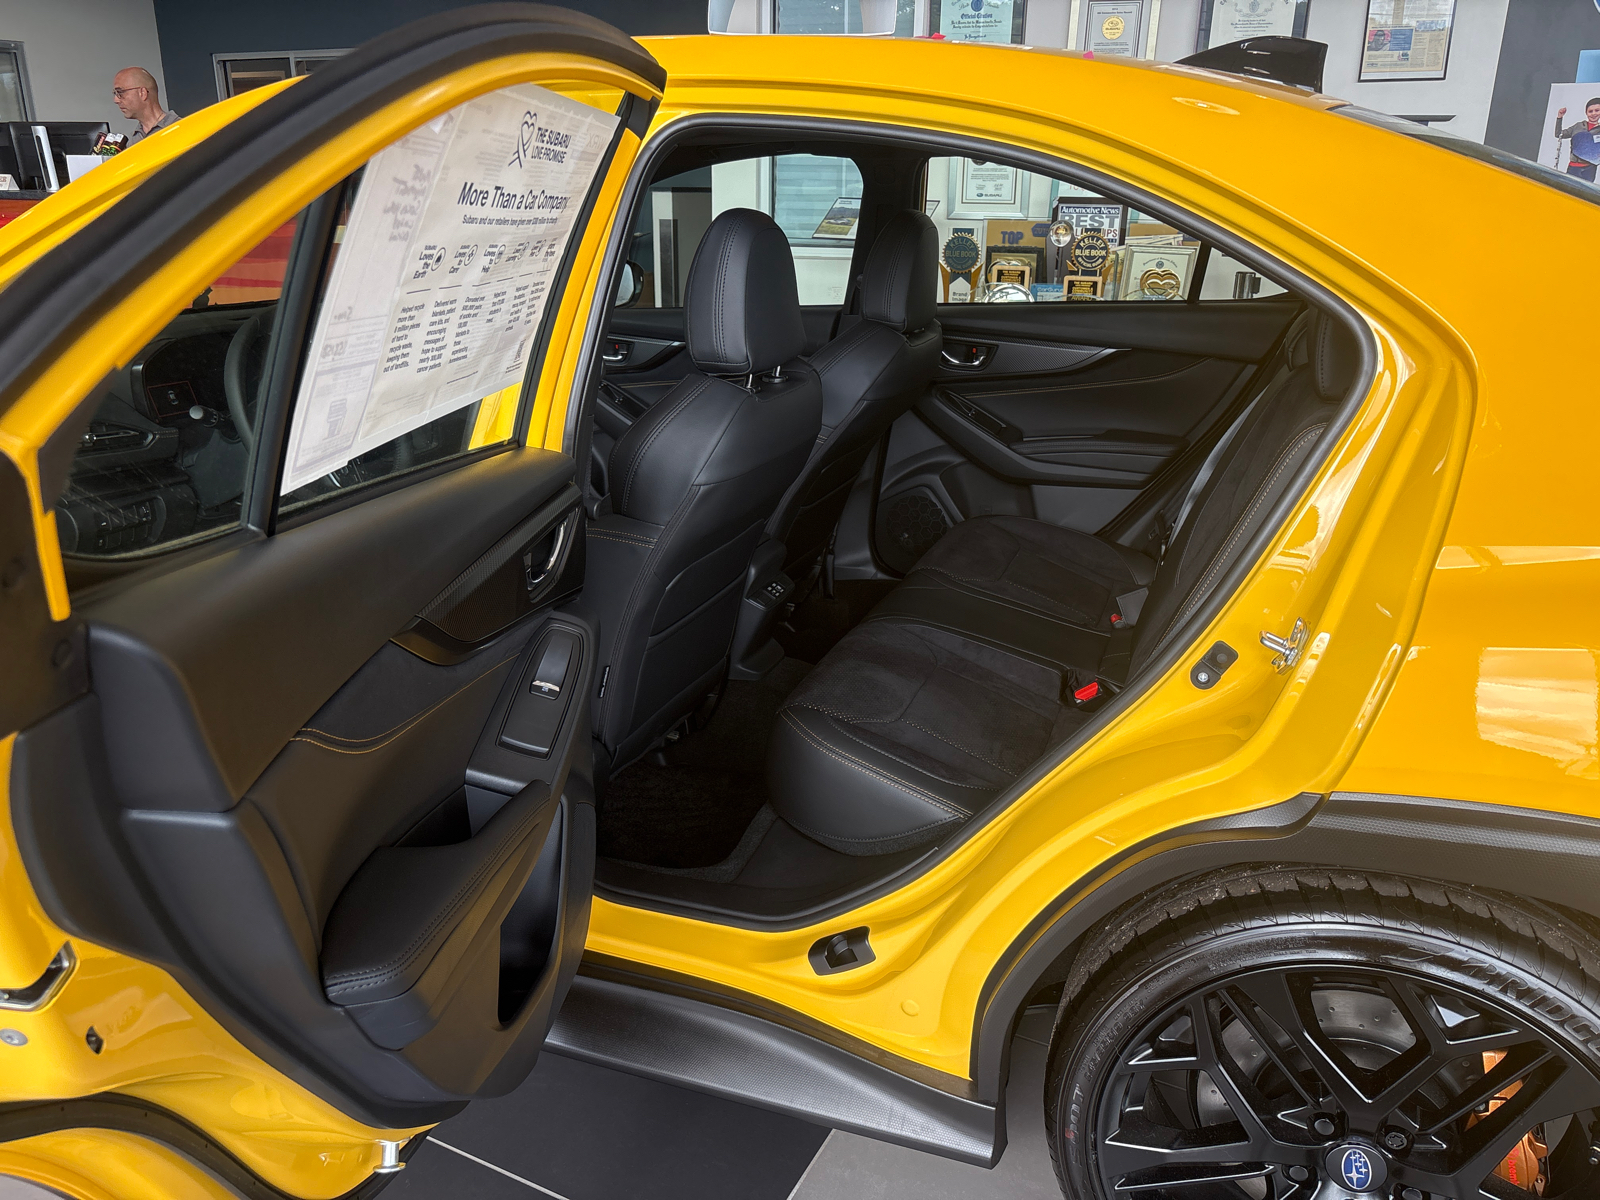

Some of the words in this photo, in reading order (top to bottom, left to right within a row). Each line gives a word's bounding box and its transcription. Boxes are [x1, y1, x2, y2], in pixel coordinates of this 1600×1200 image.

[536, 127, 548, 144] THE
[549, 130, 572, 149] SUBARU
[532, 146, 543, 160] LOVE
[543, 148, 568, 163] PROMISE
[458, 182, 489, 207] More
[491, 186, 516, 210] Than
[517, 195, 525, 210] a
[525, 190, 538, 210] Car
[538, 190, 570, 213] Company
[1062, 206, 1101, 214] Automotive
[463, 214, 479, 224] Subaru
[479, 216, 488, 225] and
[1061, 215, 1119, 228] BEST
[950, 238, 976, 249] KELLEY
[1001, 231, 1024, 245] TOP
[1080, 237, 1106, 248] KELLEY
[419, 252, 435, 260] Loves
[484, 249, 497, 257] Loves
[423, 261, 431, 270] the
[1078, 257, 1092, 268] OFFICIAL
[413, 270, 428, 279] Earth
[449, 266, 460, 274] Care
